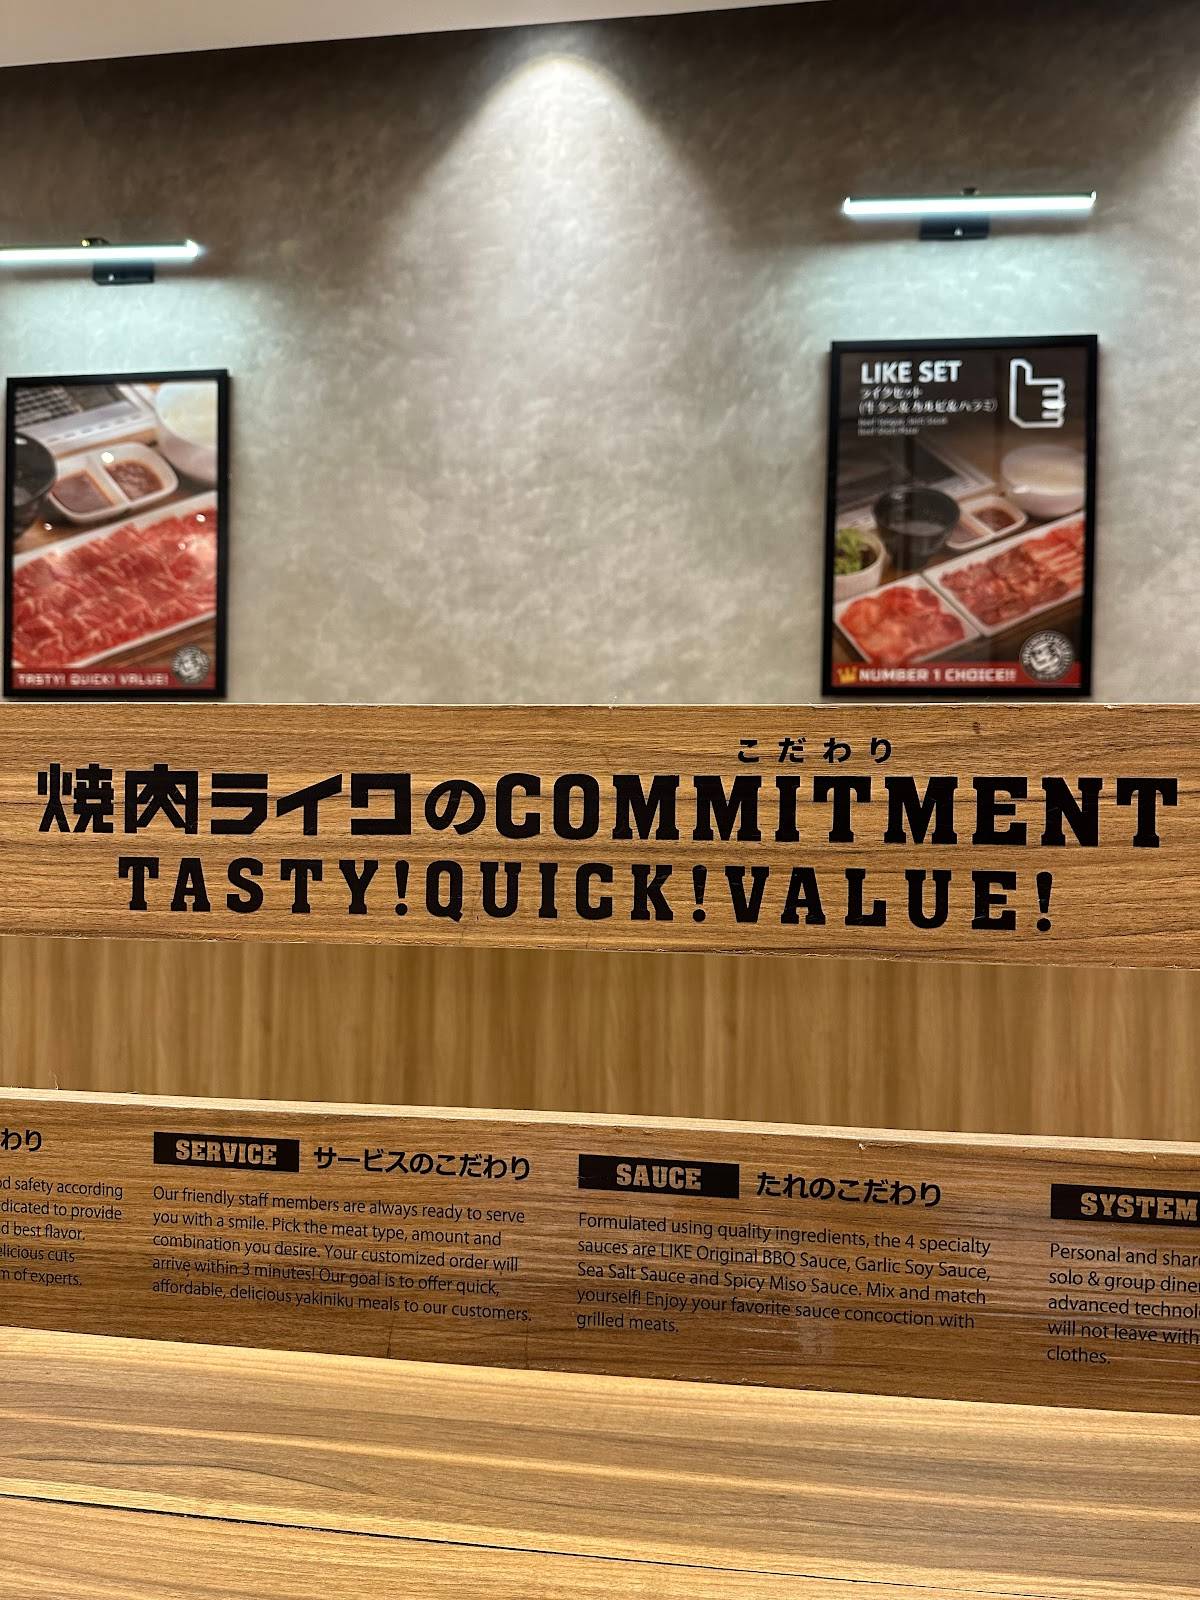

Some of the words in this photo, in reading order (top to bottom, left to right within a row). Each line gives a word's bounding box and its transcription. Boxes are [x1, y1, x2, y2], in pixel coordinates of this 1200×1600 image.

[861, 361, 912, 384] LIKE
[919, 360, 962, 382] SET
[859, 668, 928, 682] NUMBER
[934, 668, 941, 682] 1
[945, 667, 1017, 682] CHOICE!!
[737, 738, 892, 763] こだわり
[175, 1139, 277, 1166] SERVICE
[314, 1147, 530, 1181] サービスのこだわり
[15, 1176, 53, 1195] safety
[57, 1180, 122, 1199] according
[616, 1163, 701, 1190] SAUCE
[757, 1172, 941, 1207] たれのこだわり
[1, 1198, 49, 1215] dicated
[54, 1203, 66, 1216] to
[72, 1205, 121, 1220] provide
[154, 1186, 178, 1201] Our
[183, 1188, 234, 1208] friendly
[239, 1192, 268, 1207] staff
[273, 1196, 338, 1211] members
[344, 1202, 365, 1213] are
[370, 1200, 417, 1219] always
[423, 1204, 462, 1222] ready
[468, 1208, 481, 1220] to
[487, 1211, 524, 1223] serve
[1081, 1192, 1198, 1222] SYSTEM
[2, 1220, 9, 1234] d
[14, 1221, 41, 1237] best
[45, 1224, 85, 1240] flavor.
[153, 1213, 178, 1227] you
[183, 1213, 212, 1227] with
[217, 1218, 223, 1228] a
[229, 1216, 267, 1230] smile.
[270, 1217, 300, 1232] Pick
[304, 1220, 327, 1234] the
[332, 1225, 368, 1237] meat
[372, 1225, 407, 1242] type,
[412, 1230, 469, 1244] amount
[474, 1232, 501, 1246] and
[580, 1212, 666, 1233] Formulated
[672, 1221, 712, 1239] using
[718, 1223, 770, 1243] quality
[776, 1226, 869, 1248] ingredients,
[875, 1231, 900, 1248] the
[905, 1234, 914, 1249] 4
[920, 1237, 990, 1257] specialty
[0, 1243, 43, 1260] licious
[48, 1249, 74, 1262] cuts
[153, 1234, 240, 1252] combination
[245, 1243, 270, 1256] you
[275, 1241, 320, 1257] desire.
[326, 1244, 357, 1260] Your
[362, 1250, 444, 1266] customized
[450, 1254, 487, 1269] order
[493, 1257, 517, 1271] will
[578, 1241, 627, 1255] sauces
[633, 1245, 655, 1257] are
[661, 1242, 692, 1260] LIKE
[697, 1245, 757, 1265] Original
[763, 1250, 795, 1270] BBQ
[800, 1251, 850, 1272] Sauce,
[856, 1255, 900, 1273] Garlic
[905, 1258, 933, 1279] Soy
[939, 1261, 990, 1281] Sauce,
[1051, 1242, 1120, 1262] Personal
[1126, 1248, 1156, 1264] and
[1163, 1250, 1200, 1267] shar
[14, 1267, 25, 1281] of
[31, 1272, 82, 1286] experts.
[153, 1259, 190, 1272] arrive
[195, 1260, 237, 1275] within
[243, 1262, 249, 1276] 3
[255, 1266, 314, 1281] minutes!
[320, 1268, 345, 1283] Our
[350, 1271, 379, 1287] goal
[385, 1274, 394, 1286] is
[400, 1275, 414, 1288] to
[419, 1275, 452, 1290] offer
[457, 1279, 498, 1295] quick,
[578, 1261, 603, 1278] Sea
[608, 1263, 635, 1280] Salt
[641, 1265, 685, 1284] Sauce
[690, 1270, 718, 1286] and
[724, 1271, 764, 1292] Spicy
[770, 1274, 806, 1292] Miso
[812, 1277, 861, 1296] Sauce.
[867, 1281, 894, 1298] Mix
[900, 1284, 929, 1300] and
[936, 1288, 985, 1304] match
[1048, 1269, 1083, 1285] solo
[1088, 1270, 1100, 1286] &
[1105, 1276, 1155, 1293] group
[1160, 1275, 1200, 1293] dine
[153, 1279, 225, 1299] affordable,
[230, 1284, 291, 1302] delicious
[296, 1290, 353, 1307] yakiniku
[359, 1296, 399, 1310] meals
[405, 1299, 418, 1312] to
[423, 1303, 445, 1314] our
[452, 1305, 531, 1321] customers.
[578, 1289, 640, 1306] yourself!
[647, 1292, 687, 1312] Enjoy
[692, 1299, 725, 1313] your
[732, 1296, 790, 1316] favorite
[796, 1306, 839, 1319] sauce
[845, 1308, 933, 1325] concoction
[940, 1312, 974, 1328] with
[1049, 1294, 1128, 1314] advanced
[1134, 1301, 1200, 1319] technol
[577, 1312, 623, 1330] grilled
[630, 1319, 678, 1333] meats.
[1049, 1321, 1075, 1337] will
[1082, 1326, 1107, 1339] not
[1115, 1324, 1157, 1342] leave
[1163, 1328, 1198, 1344] with
[1047, 1345, 1110, 1364] clothes.
